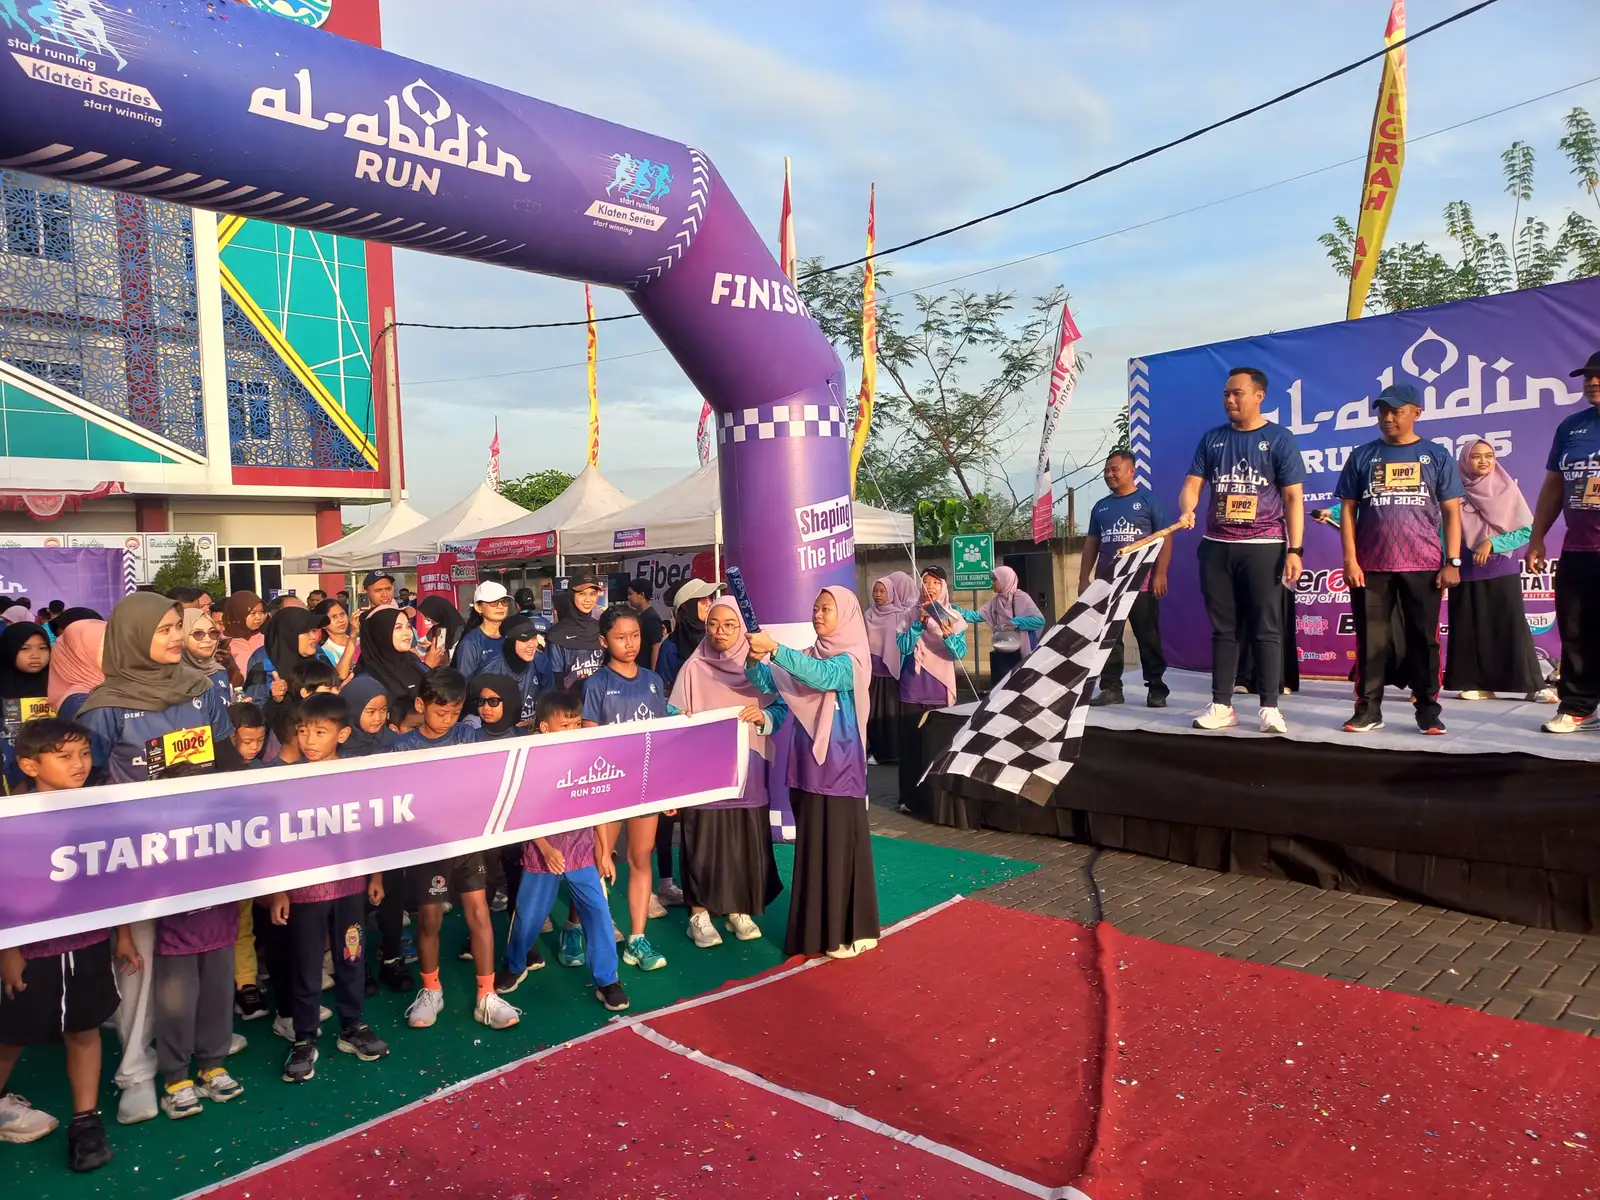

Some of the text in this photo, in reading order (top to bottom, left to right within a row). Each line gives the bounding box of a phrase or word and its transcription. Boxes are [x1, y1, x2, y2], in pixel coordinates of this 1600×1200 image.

[8, 38, 97, 72] start running
[32, 62, 151, 106] Klaten Series
[84, 99, 163, 127] start winning
[247, 68, 532, 183] al-abidin
[354, 149, 441, 196] RUN
[597, 203, 656, 227] Klaten Series
[619, 197, 660, 214] start running
[592, 219, 634, 236] start winning
[1052, 403, 1062, 420] of
[1392, 468, 1415, 477] VIP07
[1231, 500, 1252, 510] VIP02
[1303, 491, 1333, 502] TART
[800, 501, 851, 535] Shaping
[797, 544, 827, 571] The
[636, 560, 691, 589] Fiber
[1319, 591, 1335, 603] of
[172, 735, 205, 753] 10026
[556, 762, 626, 788] al-abidin
[570, 783, 611, 798] RUN 2025
[49, 793, 416, 882] STARTING LINE 1 K
